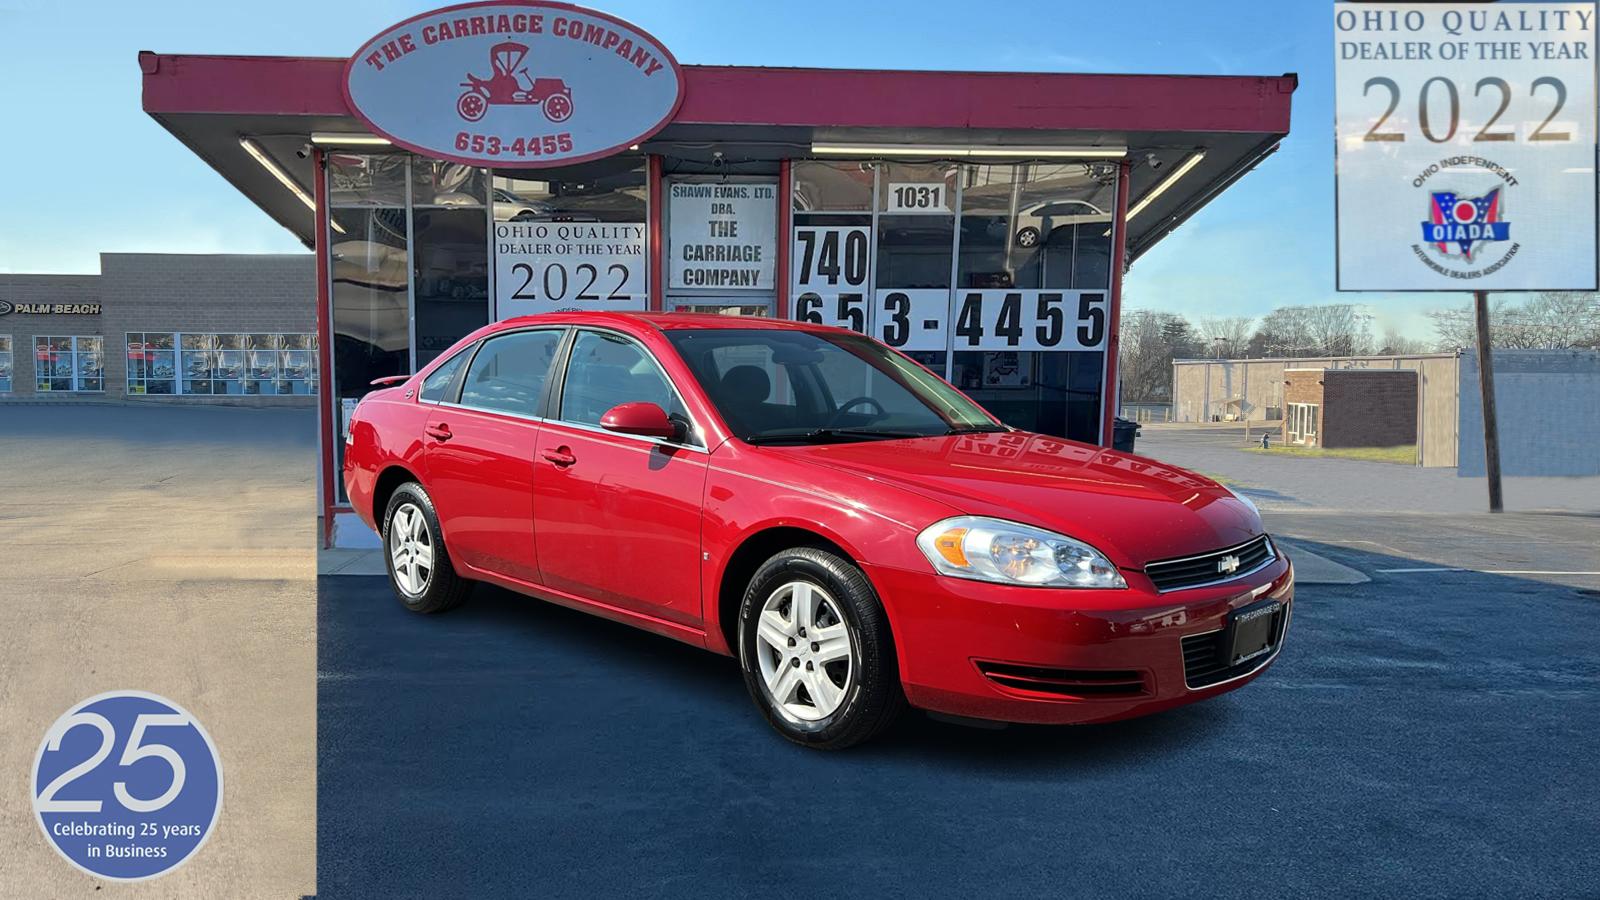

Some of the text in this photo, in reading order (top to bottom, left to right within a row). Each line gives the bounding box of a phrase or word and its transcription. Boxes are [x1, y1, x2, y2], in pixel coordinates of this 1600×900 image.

[1336, 10, 1593, 36] OHIO QUALITY
[365, 14, 663, 76] THE CARRIAGE COMPANY
[1340, 42, 1589, 60] DEALER OF THE YEAR
[1362, 76, 1571, 143] 2022
[454, 132, 573, 157] 653-4455
[1412, 155, 1519, 188] OHIO INDEPENDENT
[672, 186, 712, 199] SHAWN
[754, 187, 774, 200] LTD.
[894, 186, 940, 209] 1031
[711, 203, 736, 215] DBA.
[496, 225, 645, 241] OHIO QUALITY
[708, 220, 738, 238] THE
[1432, 224, 1496, 241] OIADA
[499, 243, 642, 255] DEALER OF THE YEAR
[682, 244, 762, 262] CARRIAGE
[797, 230, 868, 286] 740
[1411, 242, 1521, 279] AUTOMOBILE DEALERS ASSOCIATION
[511, 263, 632, 301] 2022
[682, 268, 761, 288] COMPANY
[14, 303, 100, 314] PALM BEACH
